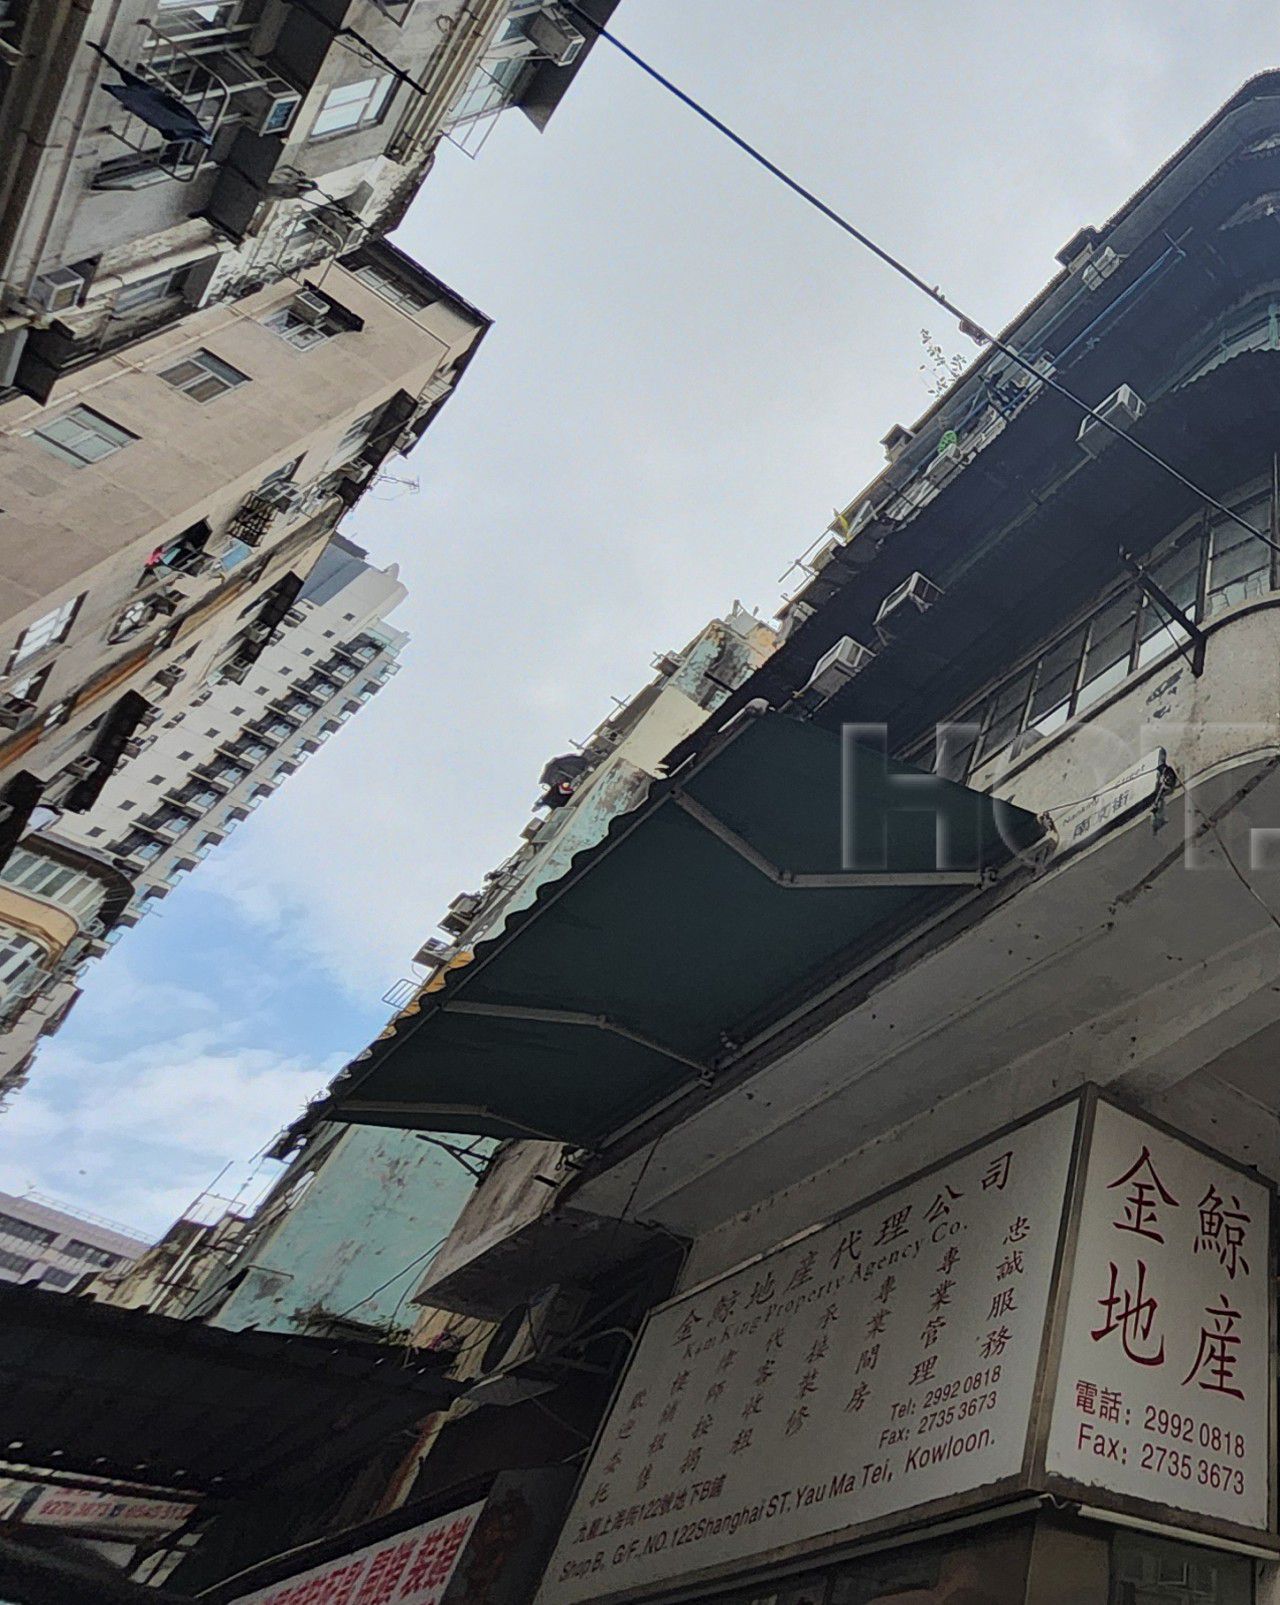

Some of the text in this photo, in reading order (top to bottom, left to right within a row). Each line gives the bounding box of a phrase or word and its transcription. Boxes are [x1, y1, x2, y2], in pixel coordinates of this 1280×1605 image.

[850, 1238, 924, 1284] Agency
[931, 1220, 968, 1245] Co.
[980, 1215, 1031, 1360] 忠誠服務
[878, 1390, 997, 1449] Fax: 2735 3673
[891, 1365, 1001, 1421] Tel: 2992 0818
[1077, 1422, 1244, 1495] Fax: 2735 3673
[1144, 1405, 1194, 1443] 2992
[1199, 1422, 1245, 1458] 0818
[796, 1484, 827, 1509] Yau
[828, 1473, 856, 1499] Ma
[862, 1458, 893, 1487] Tei,
[905, 1428, 995, 1473] Kowloon.
